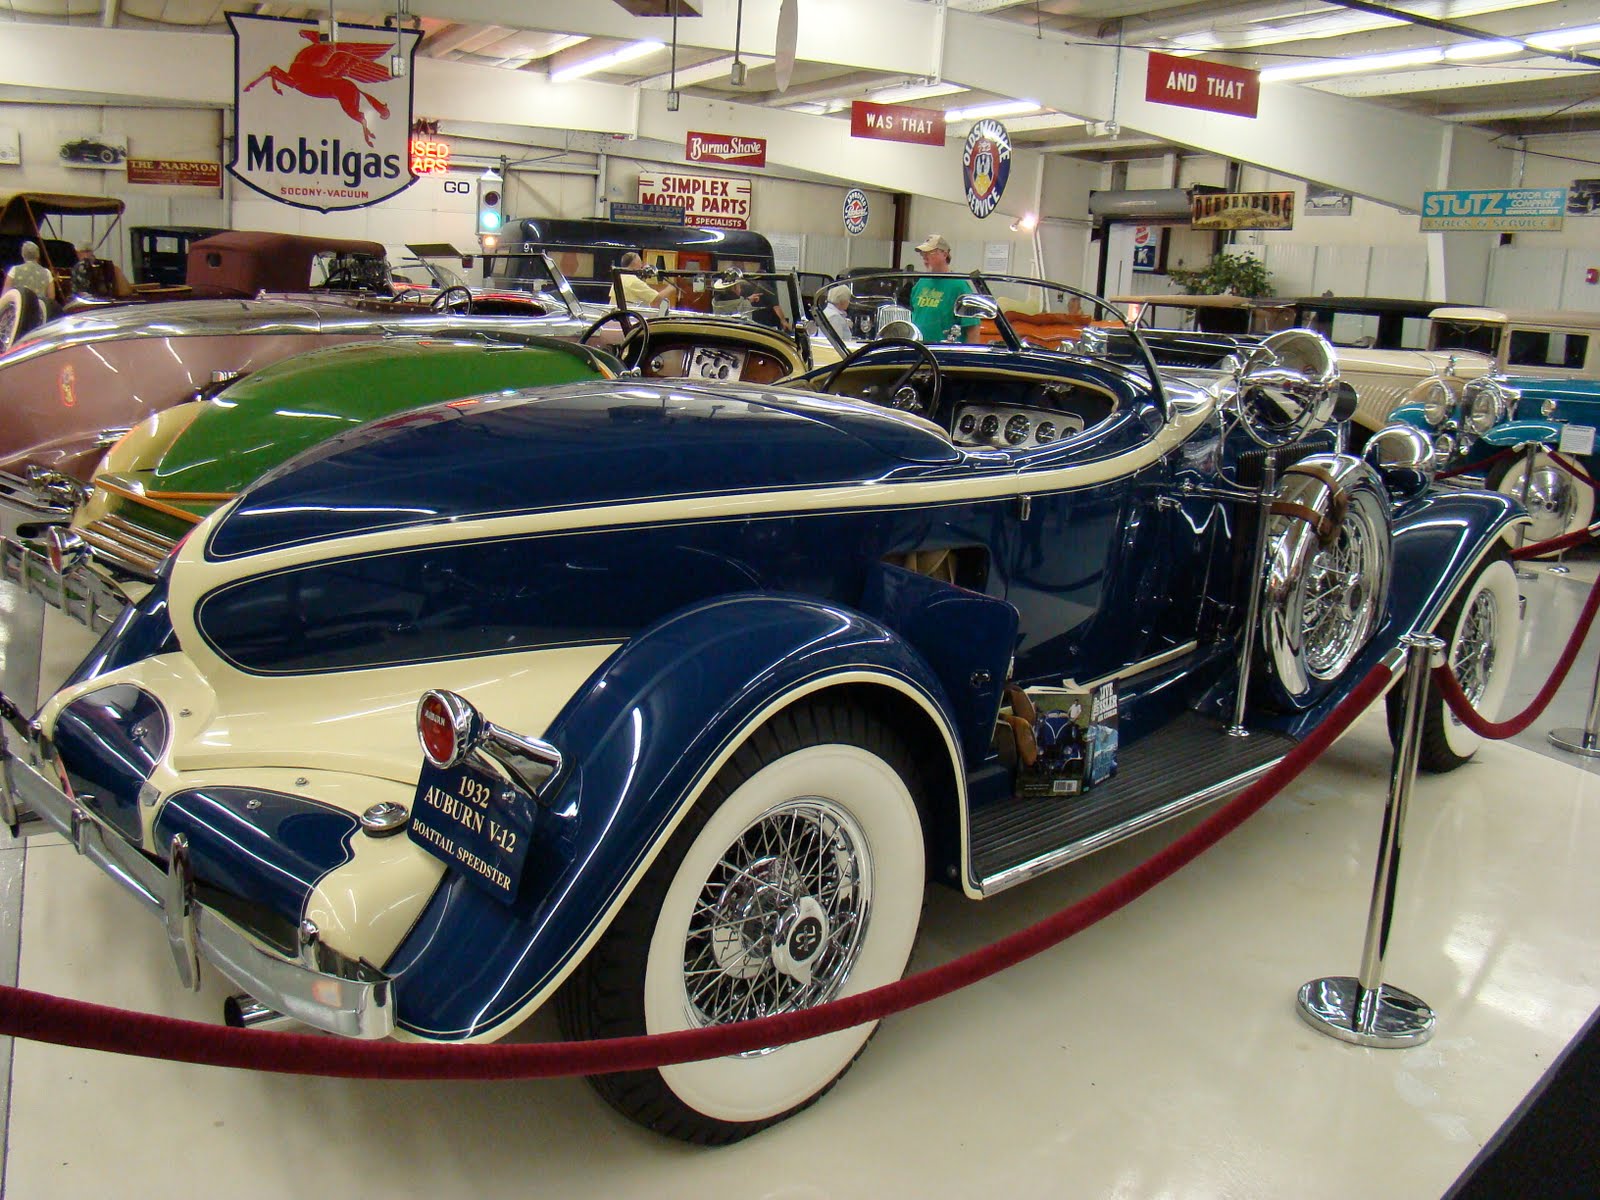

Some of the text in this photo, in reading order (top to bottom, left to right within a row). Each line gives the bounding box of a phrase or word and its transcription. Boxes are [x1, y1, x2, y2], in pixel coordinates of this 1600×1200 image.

[1167, 71, 1245, 101] AND THAT
[866, 113, 933, 135] WAS THAT
[690, 137, 762, 160] Burma Shave
[963, 119, 1010, 167] OLDSMOBILE
[131, 161, 218, 172] THE MARMON
[247, 133, 401, 188] Mobilgas
[411, 158, 449, 174] ARS
[280, 187, 369, 199] SOCONY-VACUUM
[444, 181, 470, 194] GO
[661, 176, 729, 197] SIMPLEX
[1506, 191, 1542, 200] MOTOR
[701, 197, 747, 216] PARTS
[967, 187, 1000, 217] SERVICE
[1425, 192, 1504, 216] STUTZ
[695, 217, 742, 228] SPECIALISTS
[424, 710, 446, 727] AUBURN
[458, 775, 490, 809] 1932
[423, 784, 517, 853] AUBURN V-12
[412, 817, 455, 856] BOATTAIL
[457, 846, 512, 891] SPEEDSTER
